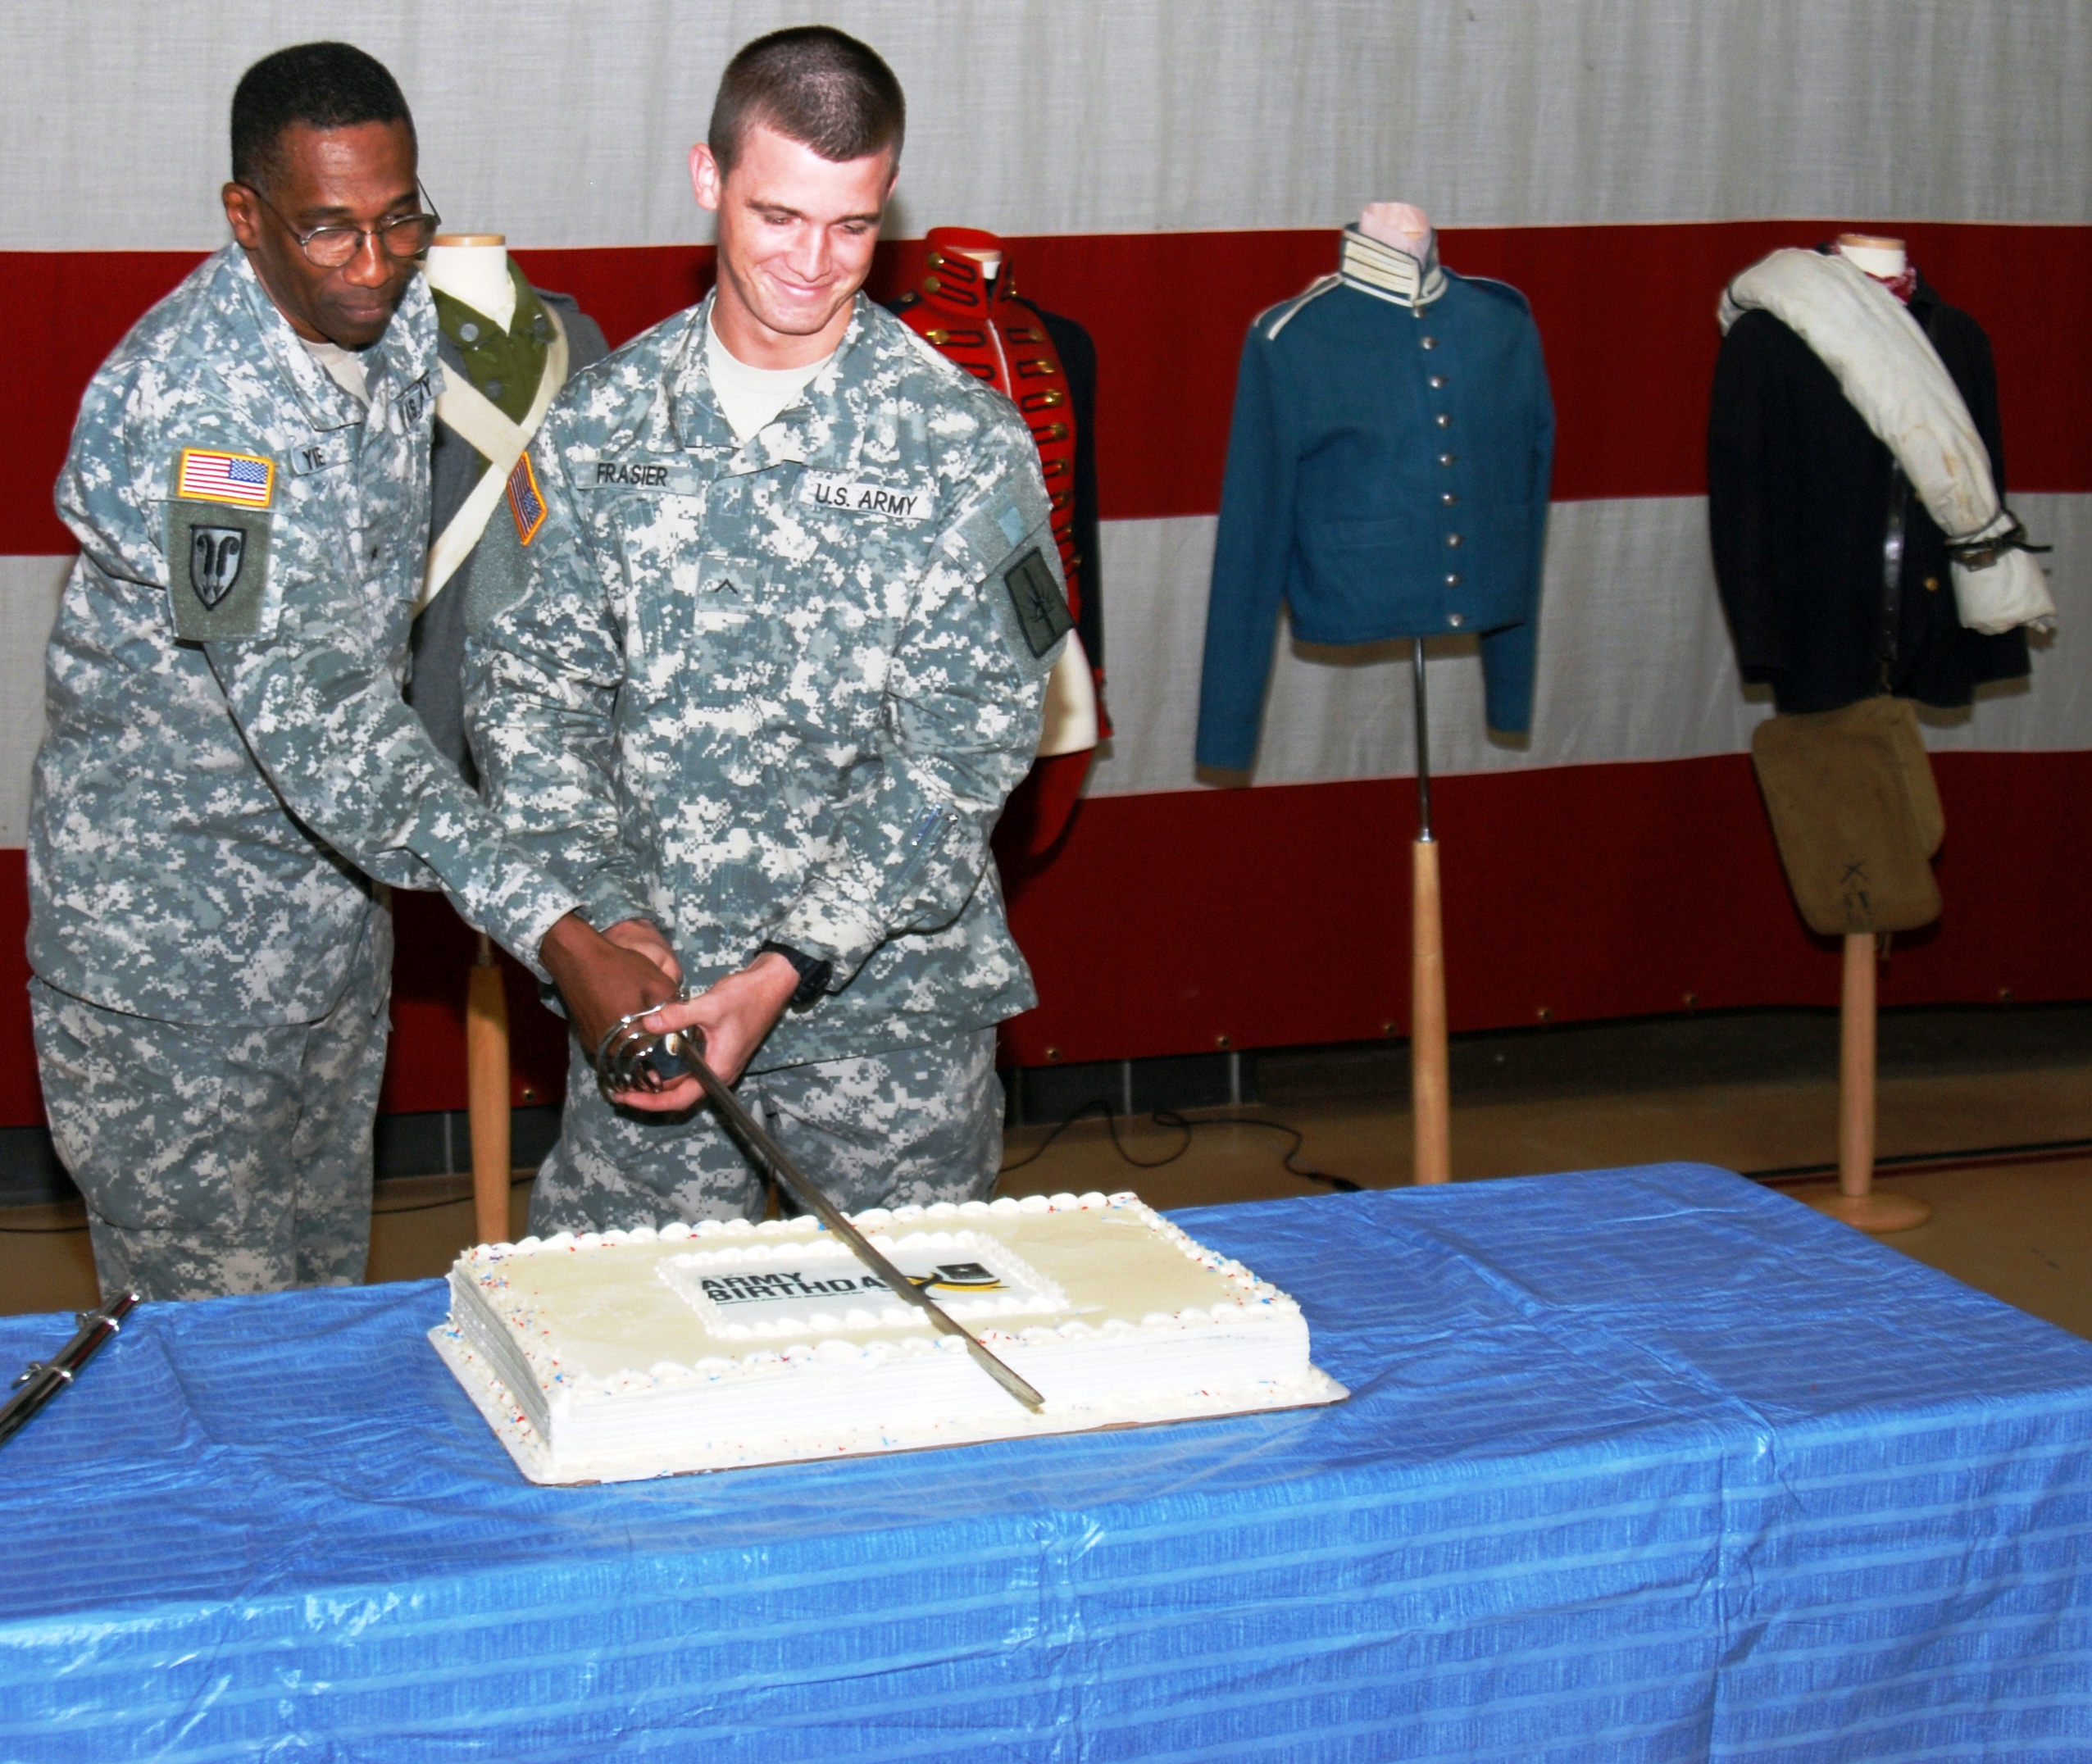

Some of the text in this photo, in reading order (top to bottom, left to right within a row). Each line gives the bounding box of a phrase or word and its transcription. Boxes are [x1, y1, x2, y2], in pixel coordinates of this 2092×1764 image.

[597, 463, 668, 486] FRASIER
[815, 484, 918, 516] U.S. ARMY
[702, 1272, 801, 1290] ARMY
